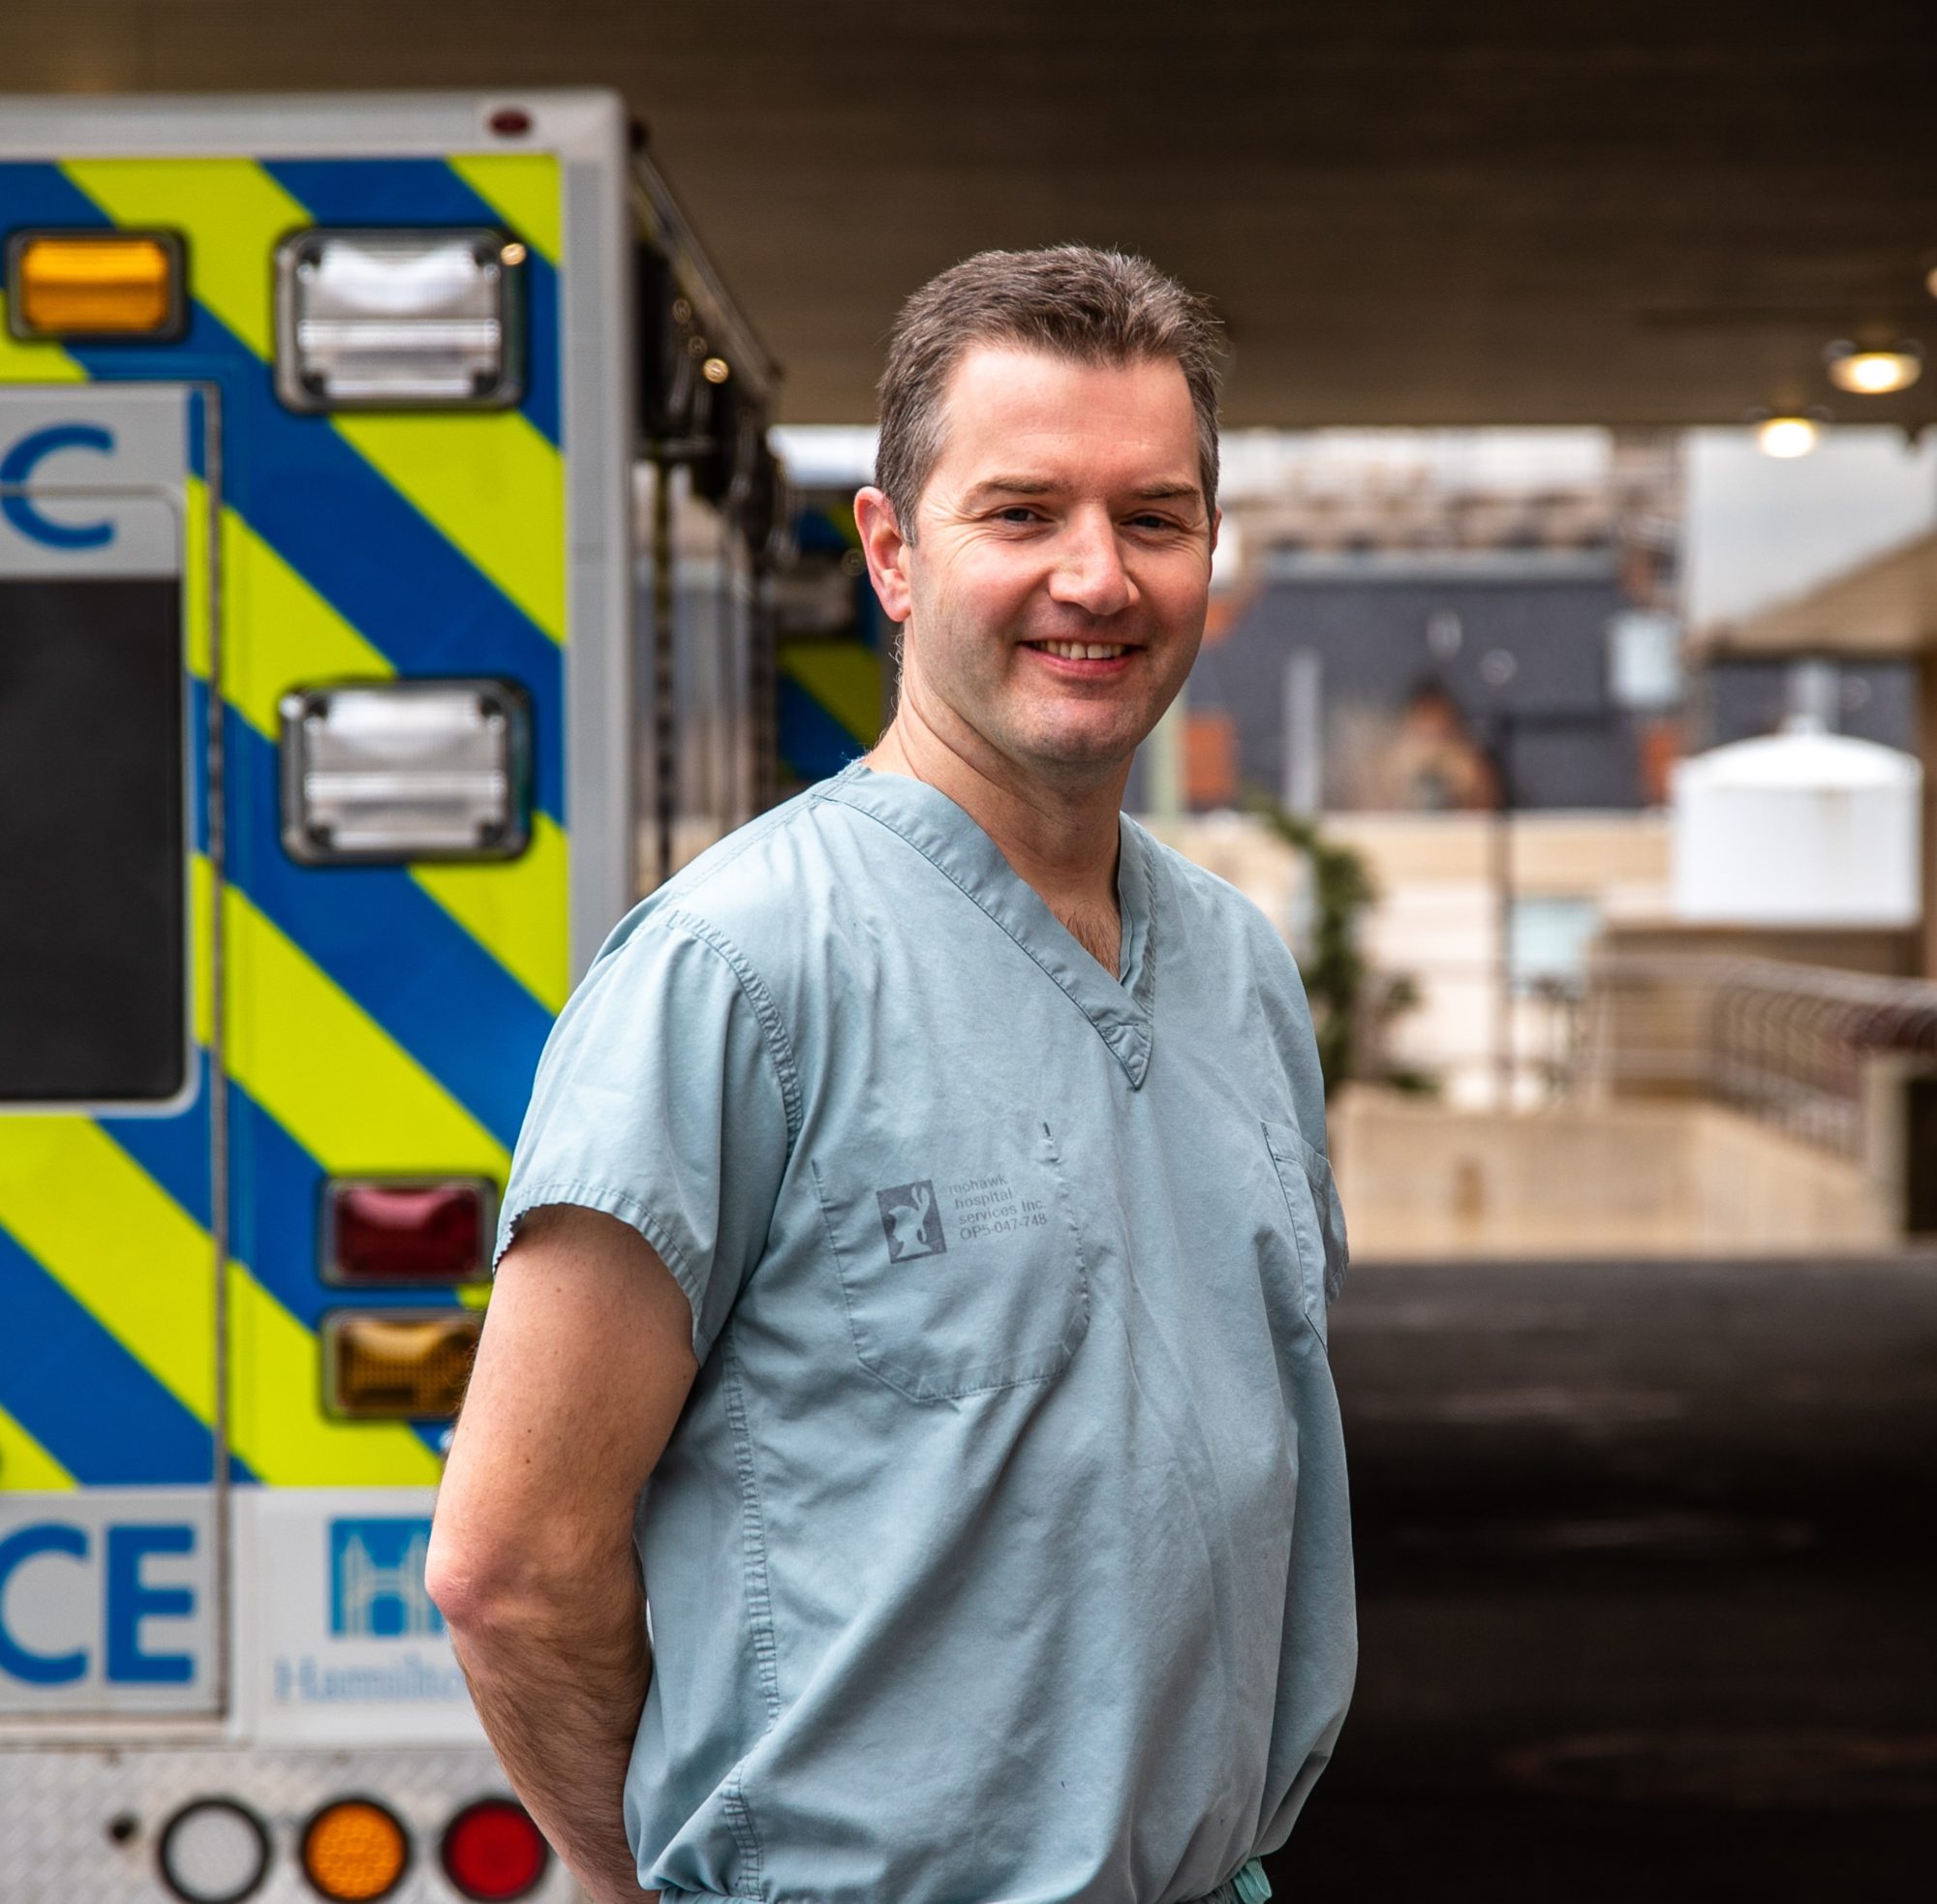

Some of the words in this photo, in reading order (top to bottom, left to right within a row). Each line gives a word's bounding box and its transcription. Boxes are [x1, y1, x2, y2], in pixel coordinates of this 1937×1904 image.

[949, 1173, 1007, 1194] mohawk
[954, 1187, 1012, 1209] hospital
[959, 1205, 1017, 1225] services
